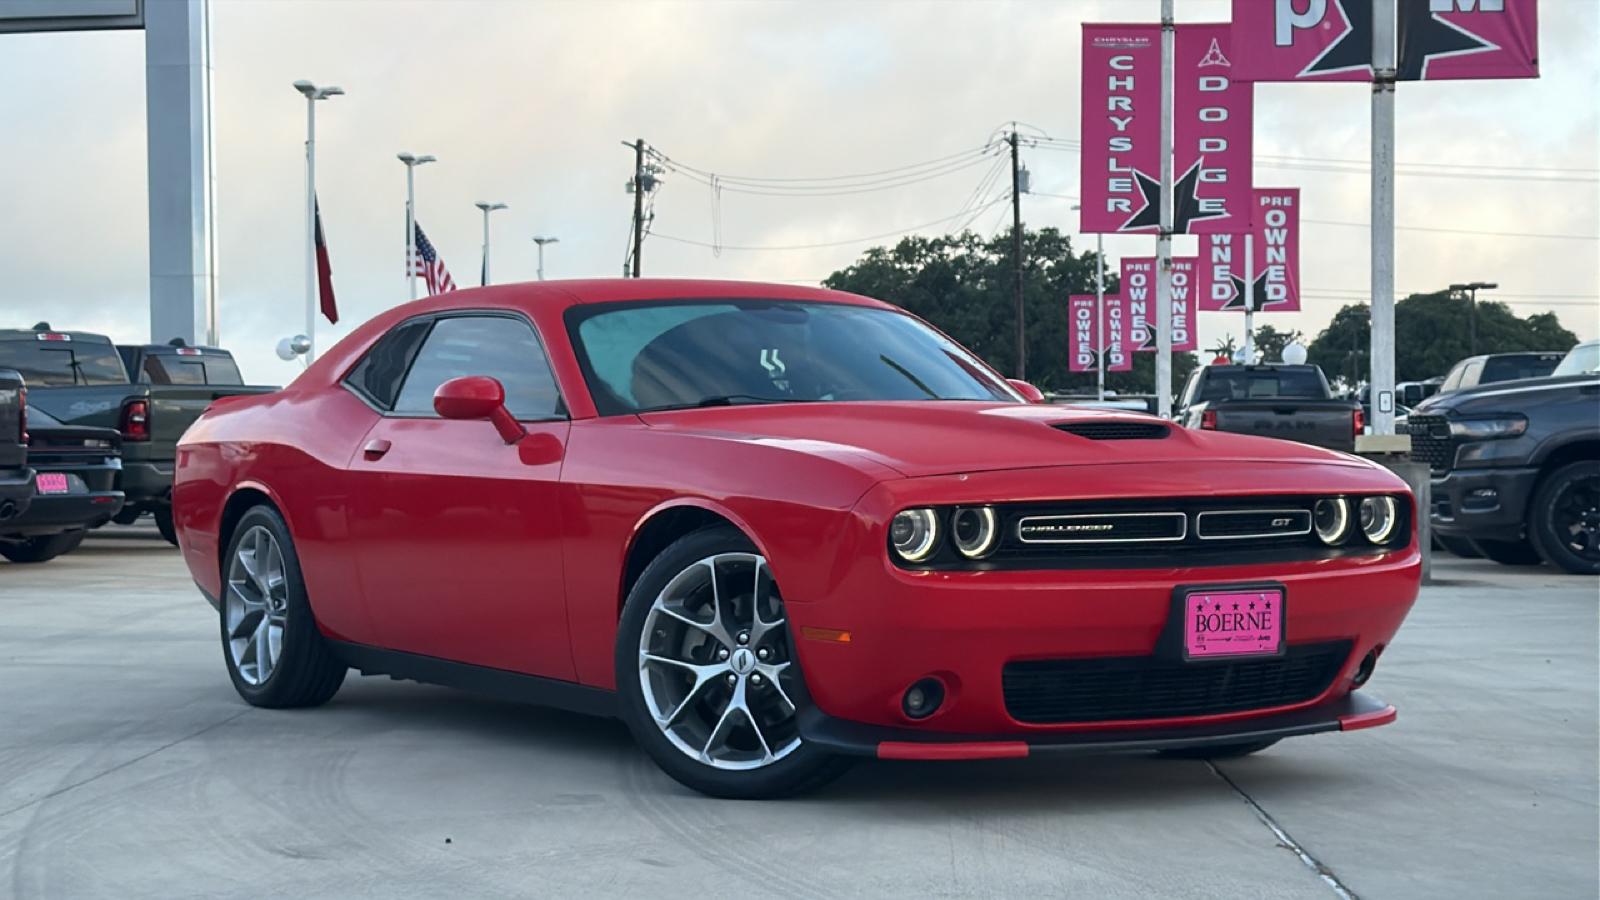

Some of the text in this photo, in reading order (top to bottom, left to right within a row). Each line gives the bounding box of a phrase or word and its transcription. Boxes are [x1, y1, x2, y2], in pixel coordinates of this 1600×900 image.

[1107, 55, 1135, 213] CHRYSLER
[1198, 76, 1229, 213] DODGE
[1261, 196, 1292, 206] PRE
[1126, 263, 1151, 271] PRE
[1211, 234, 1231, 300] WNED
[1264, 209, 1287, 300] OWNED
[1129, 273, 1148, 342] OWNED
[1171, 272, 1188, 342] OWNED
[1076, 308, 1091, 365] OWNED
[1109, 308, 1124, 364] OWNED
[1021, 524, 1114, 532] CHALLENGER
[1270, 518, 1293, 526] GT
[1195, 612, 1272, 632] BOERNE
